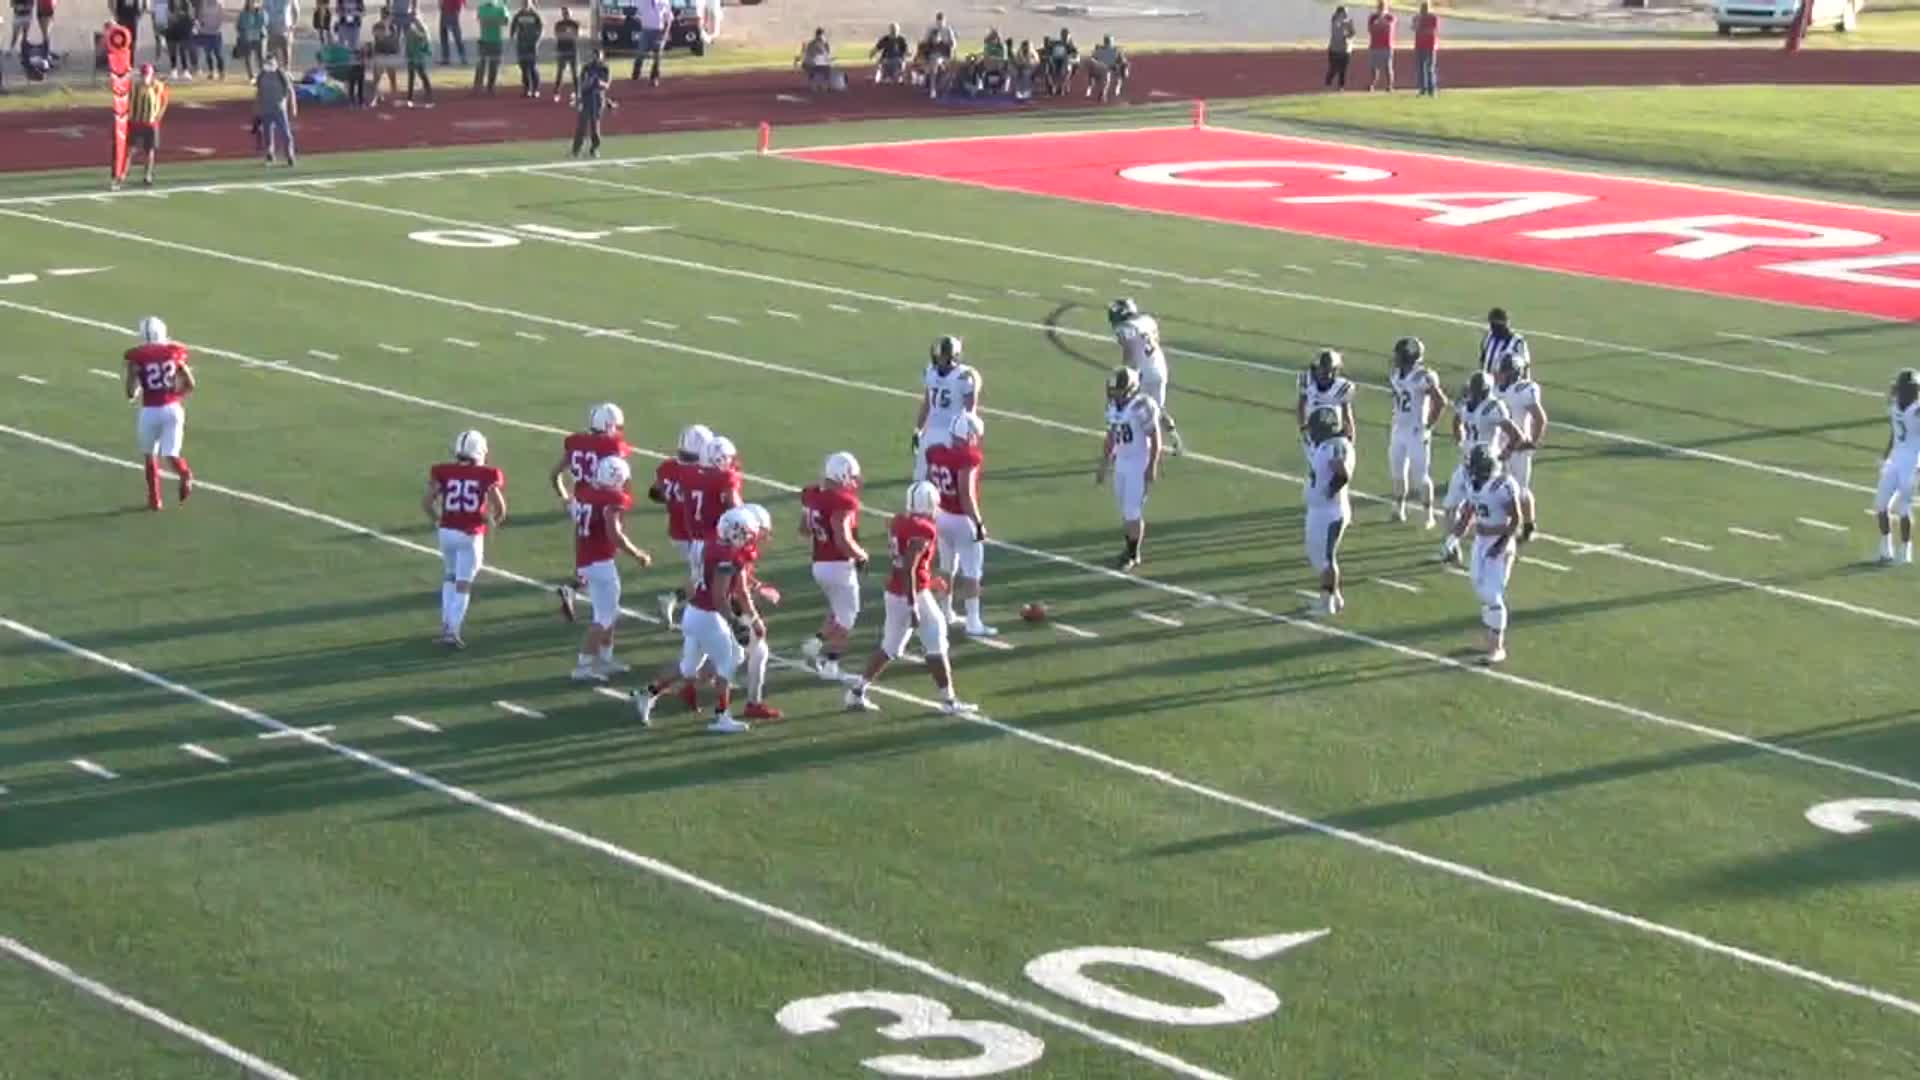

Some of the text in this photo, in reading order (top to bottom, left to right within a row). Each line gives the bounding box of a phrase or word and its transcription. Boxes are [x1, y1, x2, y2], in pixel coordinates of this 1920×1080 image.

[146, 360, 177, 389] 22
[571, 449, 599, 483] 53
[444, 479, 480, 512] 25
[690, 489, 704, 521] 7
[776, 945, 1281, 1078] 30
